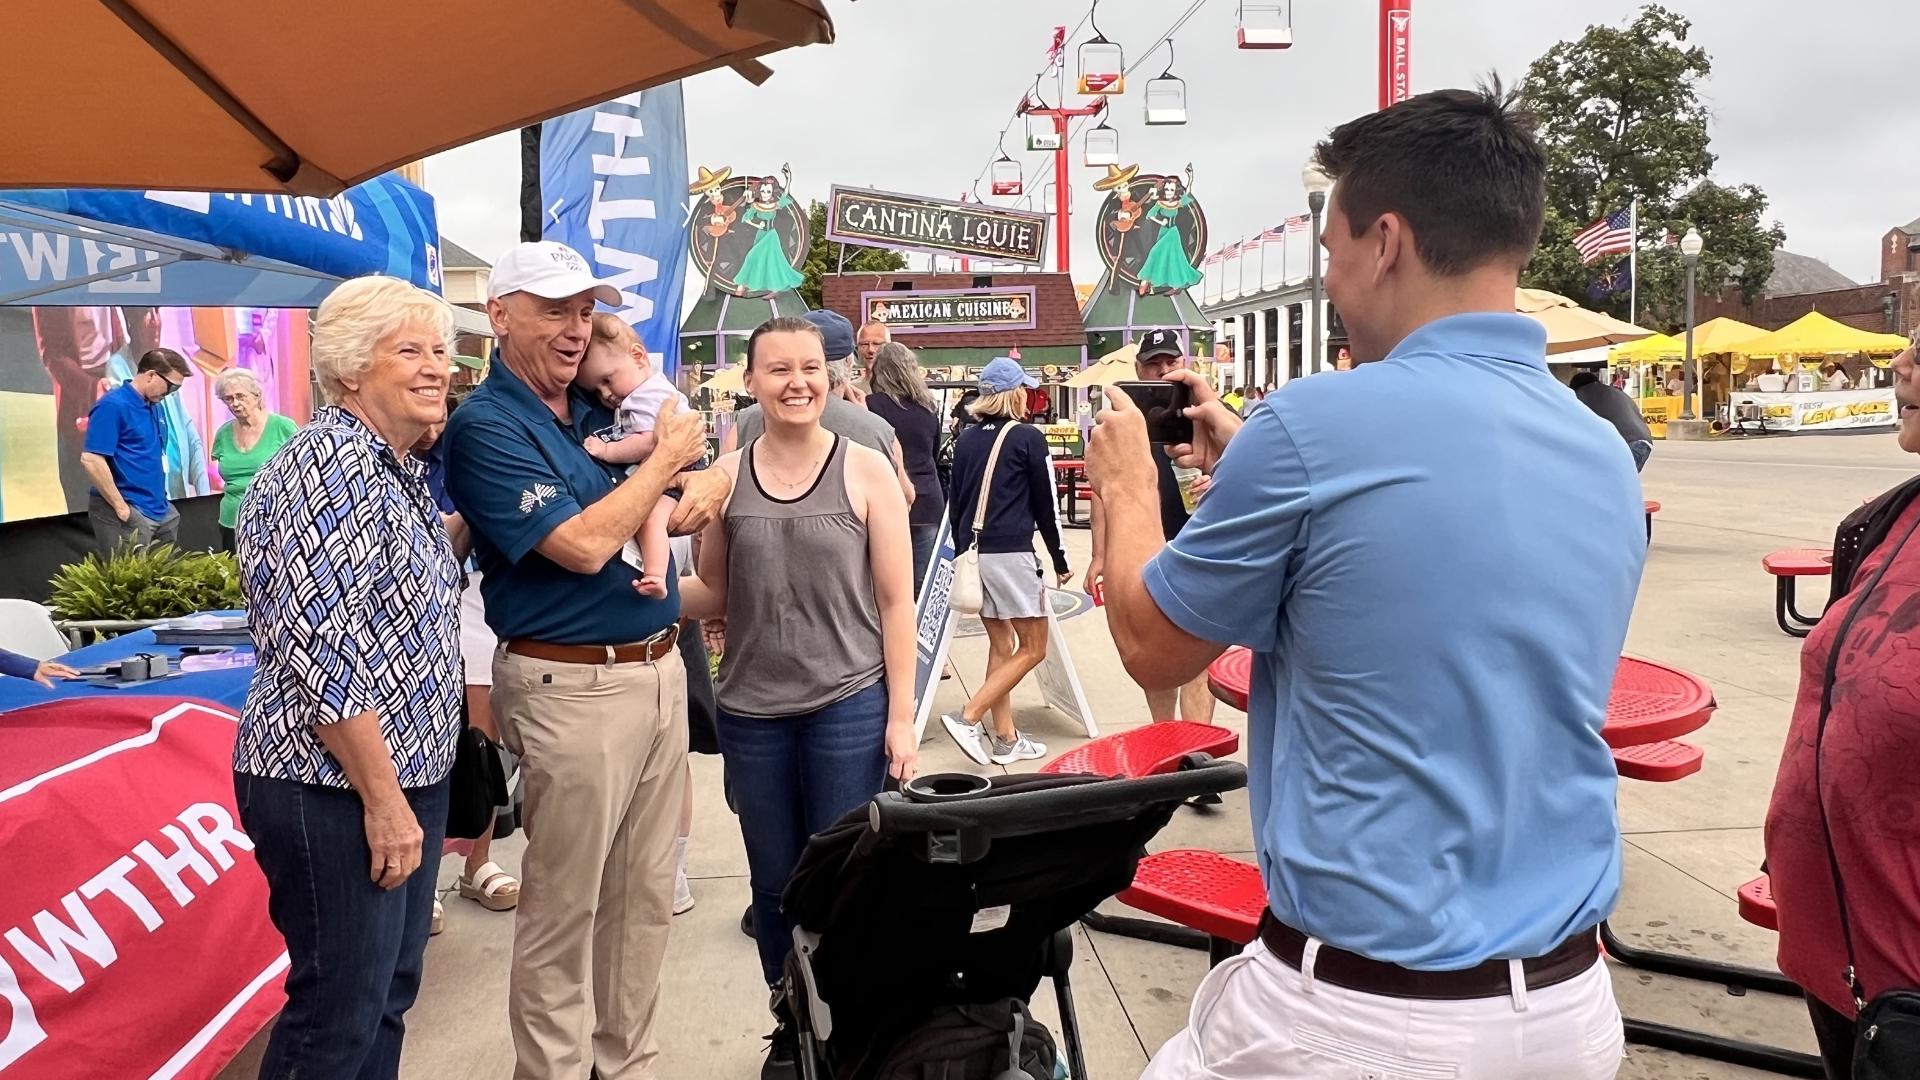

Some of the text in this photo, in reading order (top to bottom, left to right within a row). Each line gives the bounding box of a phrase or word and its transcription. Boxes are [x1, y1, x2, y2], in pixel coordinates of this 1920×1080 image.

[1396, 37, 1406, 102] BALL STAT
[587, 91, 659, 327] WTH
[845, 204, 1031, 250] CANTINA LOUIE
[888, 301, 1011, 319] MEXICAN CUISINE
[3, 802, 255, 994] WTHR
